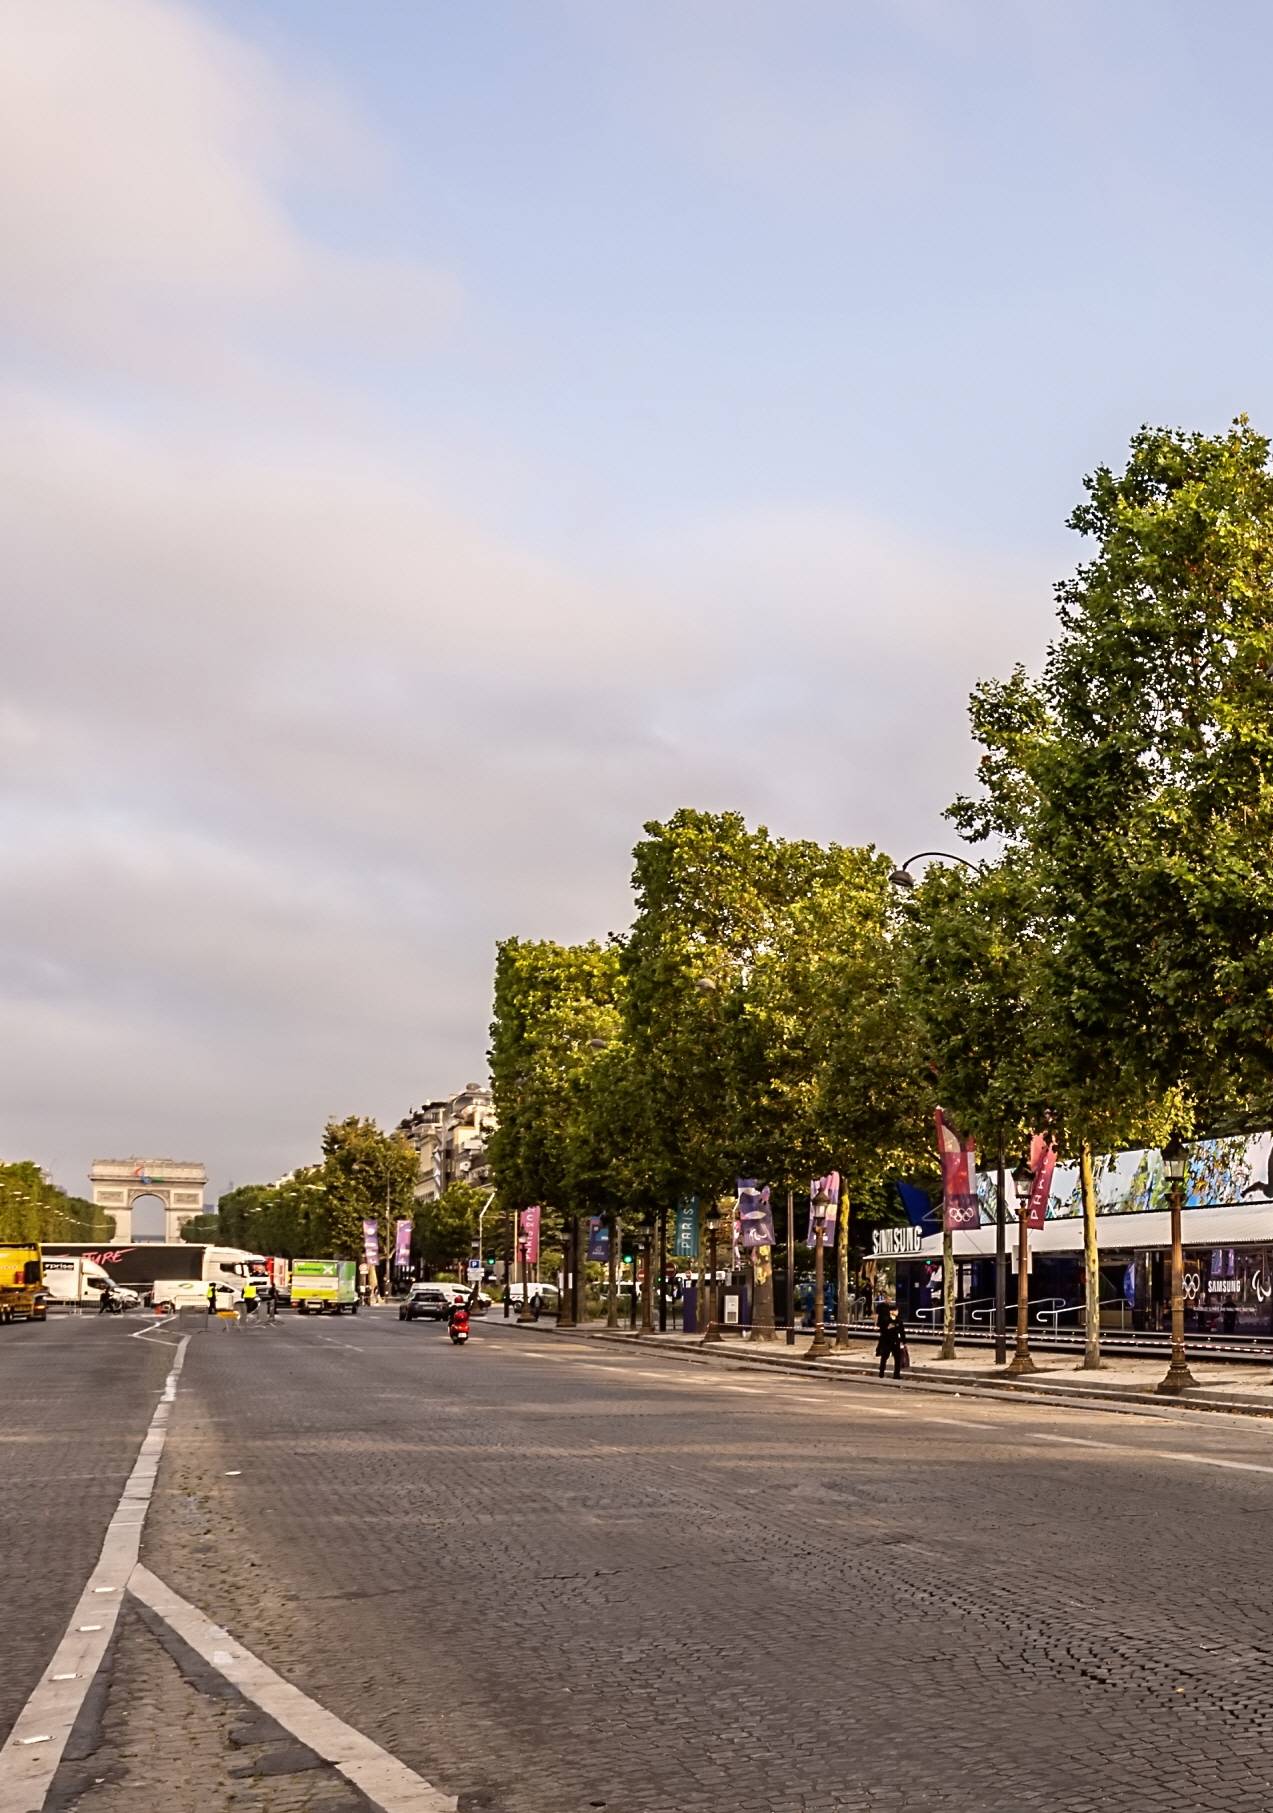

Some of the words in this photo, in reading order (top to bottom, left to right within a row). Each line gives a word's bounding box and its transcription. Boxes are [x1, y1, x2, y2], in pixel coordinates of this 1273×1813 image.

[681, 1208, 694, 1249] PARIS
[872, 1225, 923, 1254] SAMSUNG
[1208, 1280, 1241, 1293] SAMSUNG
